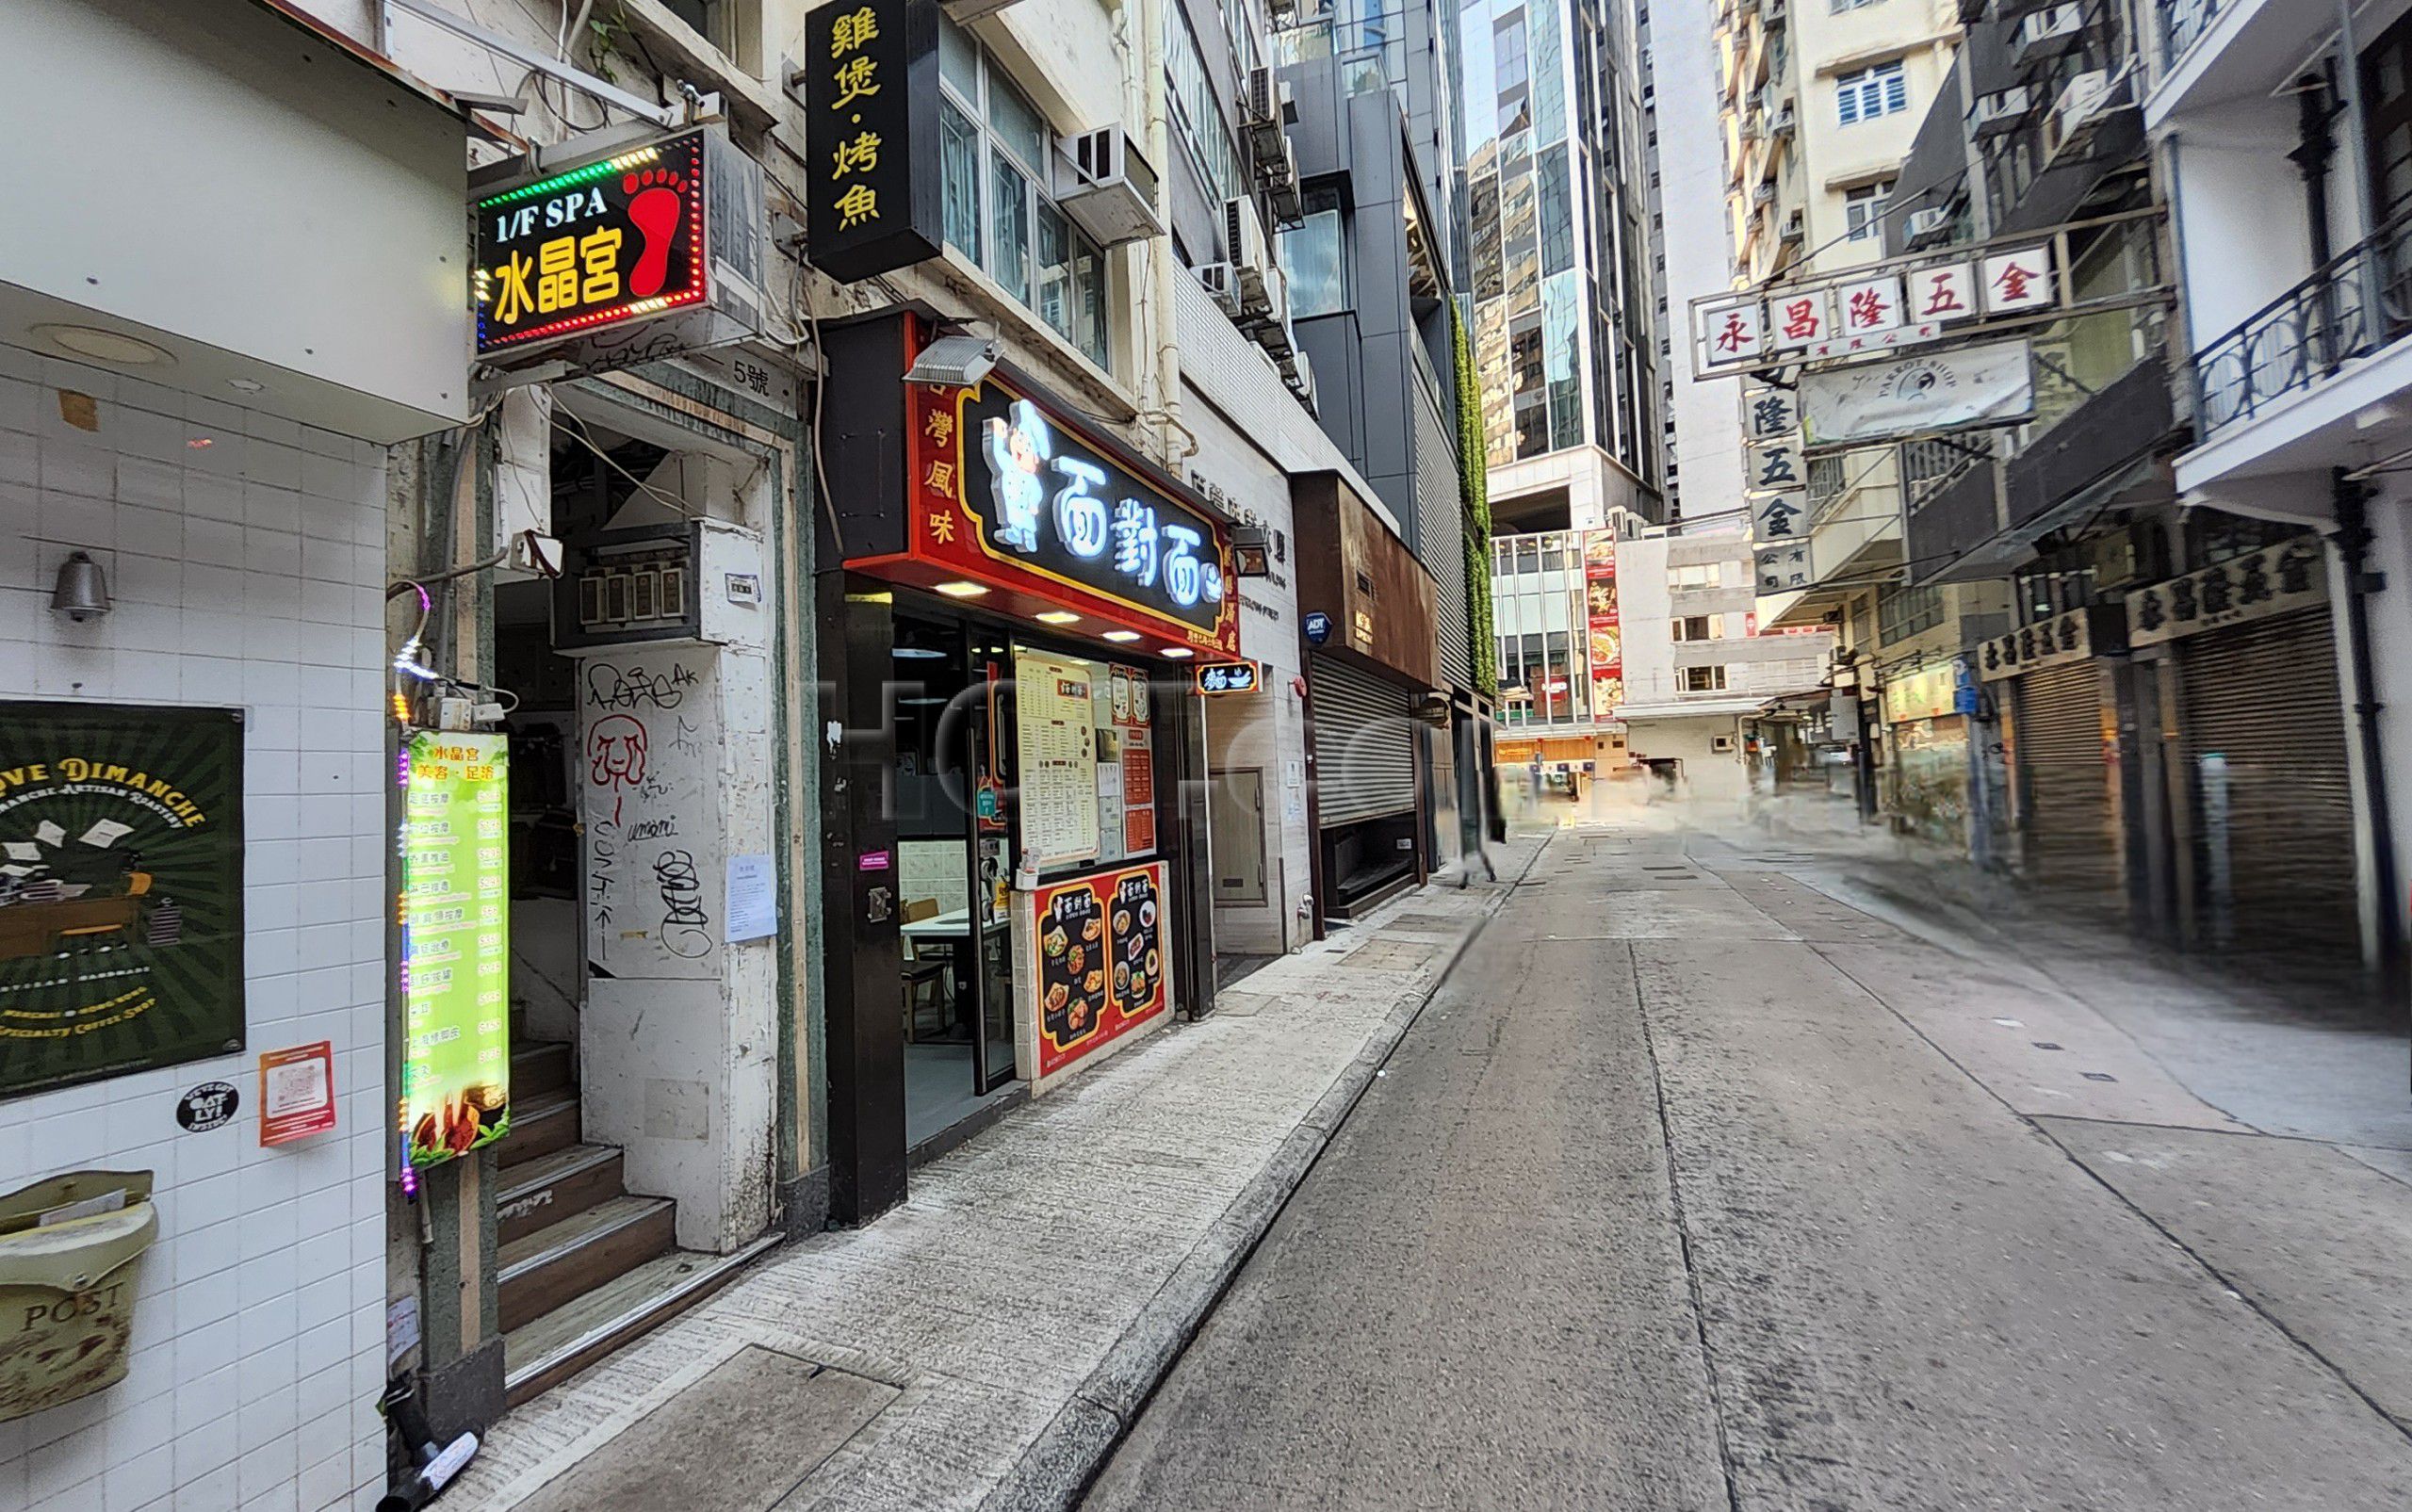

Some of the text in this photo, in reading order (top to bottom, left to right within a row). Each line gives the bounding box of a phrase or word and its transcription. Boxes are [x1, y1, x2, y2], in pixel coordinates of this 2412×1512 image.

[496, 187, 608, 243] 1/F SPA
[494, 225, 623, 325] 水晶宮
[1714, 261, 2041, 354] 永昌隆五金
[1051, 455, 1202, 610] 面對面
[1307, 618, 1326, 631] ADT
[1203, 667, 1228, 691] 麵
[0, 756, 206, 828] VE DIMANCHE
[19, 1281, 126, 1332] POST
